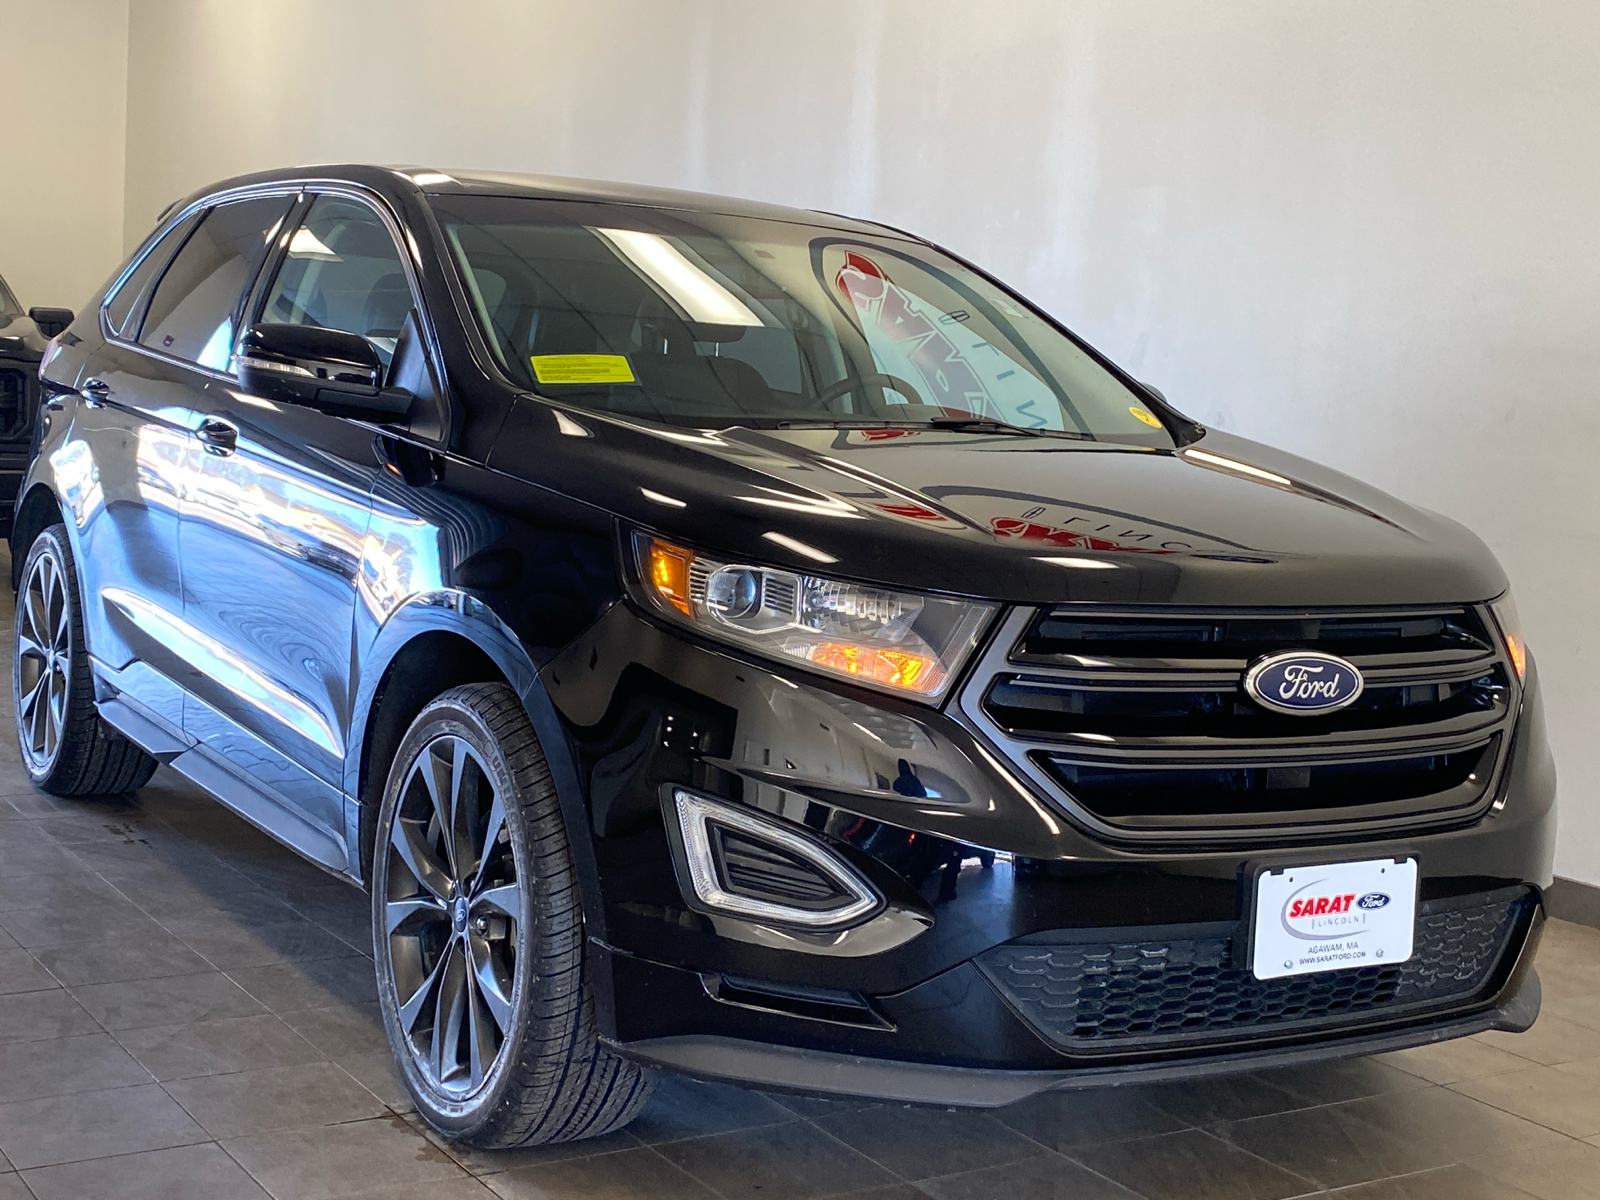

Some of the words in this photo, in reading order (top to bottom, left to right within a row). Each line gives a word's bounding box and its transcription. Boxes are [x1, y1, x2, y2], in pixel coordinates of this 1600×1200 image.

[1279, 665, 1340, 699] Ford
[1289, 893, 1356, 918] SARAT
[1361, 895, 1386, 908] Ford
[1319, 917, 1359, 926] LINCOLN
[1308, 943, 1345, 954] AGAWAM,
[1346, 942, 1359, 950] MA
[1300, 952, 1366, 964] WWW.SARATFORD.COM
